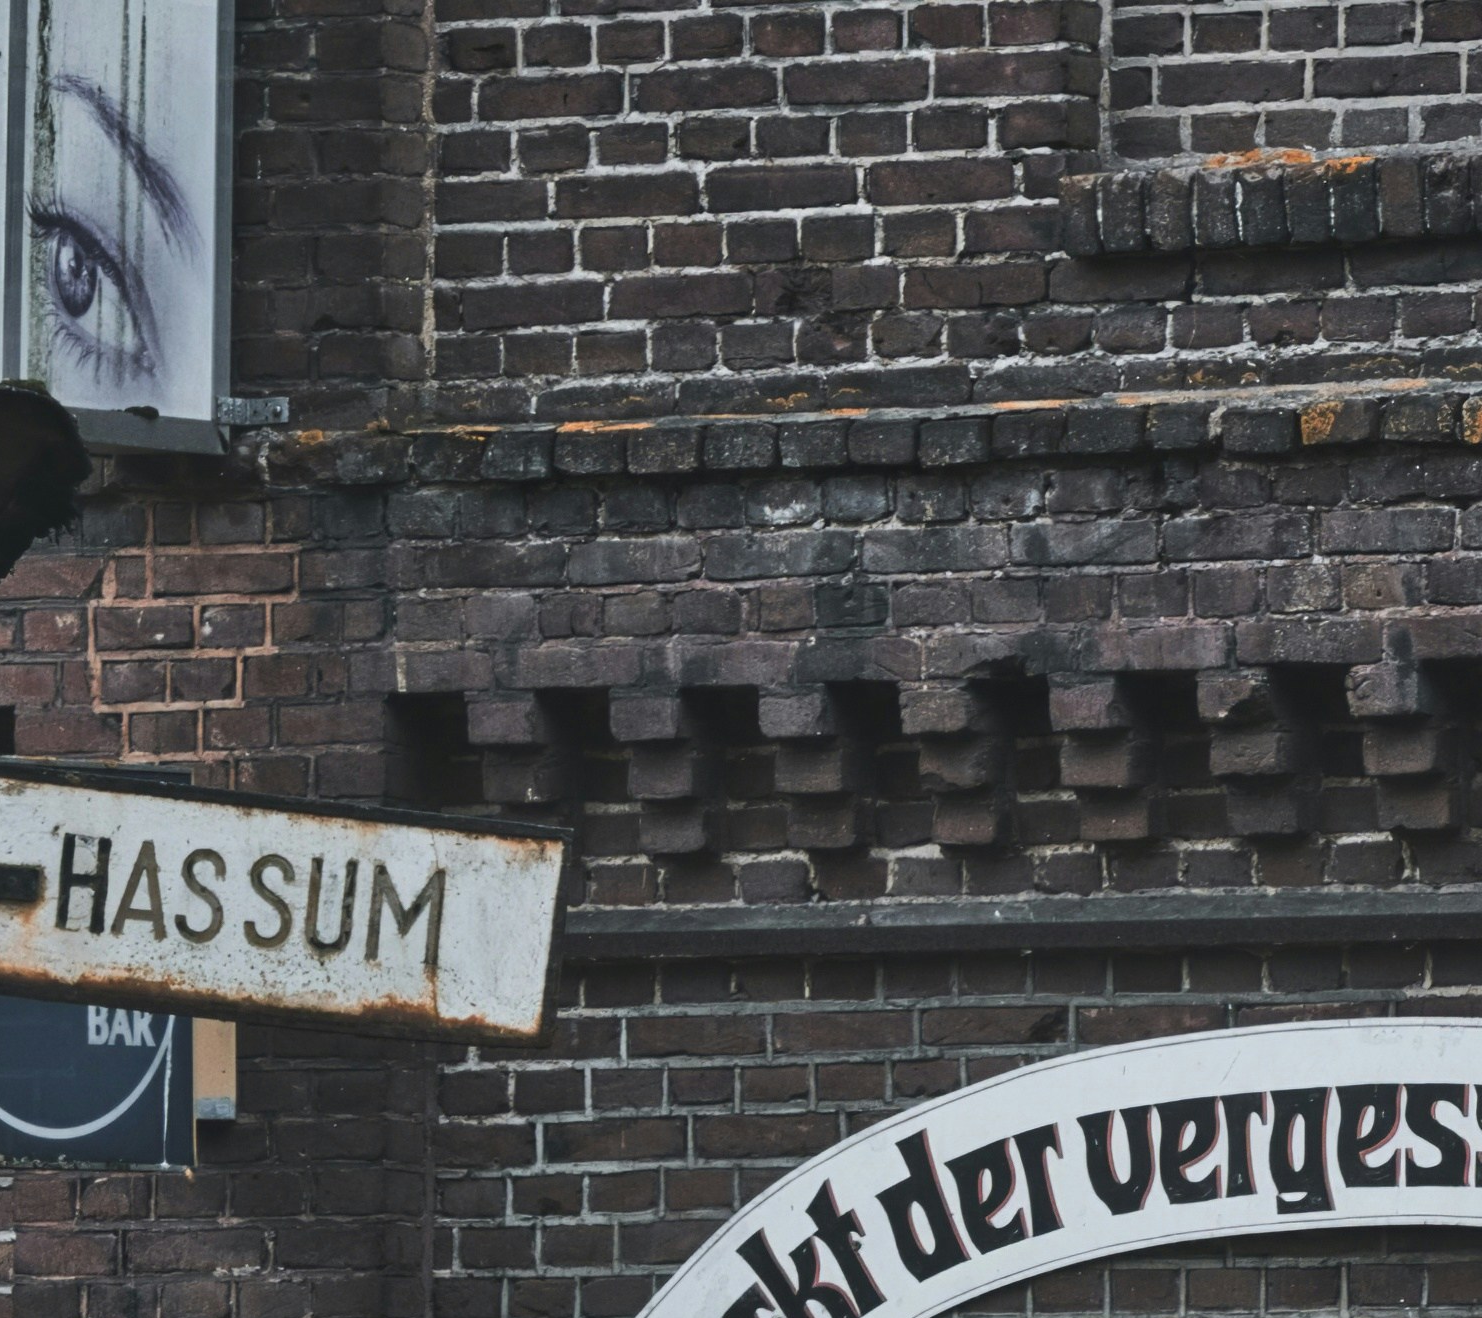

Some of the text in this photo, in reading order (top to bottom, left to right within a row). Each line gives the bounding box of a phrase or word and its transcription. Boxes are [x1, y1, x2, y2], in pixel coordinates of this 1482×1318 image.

[53, 831, 447, 971] HASSUM
[87, 1004, 156, 1047] BAR
[876, 1120, 1067, 1283] der
